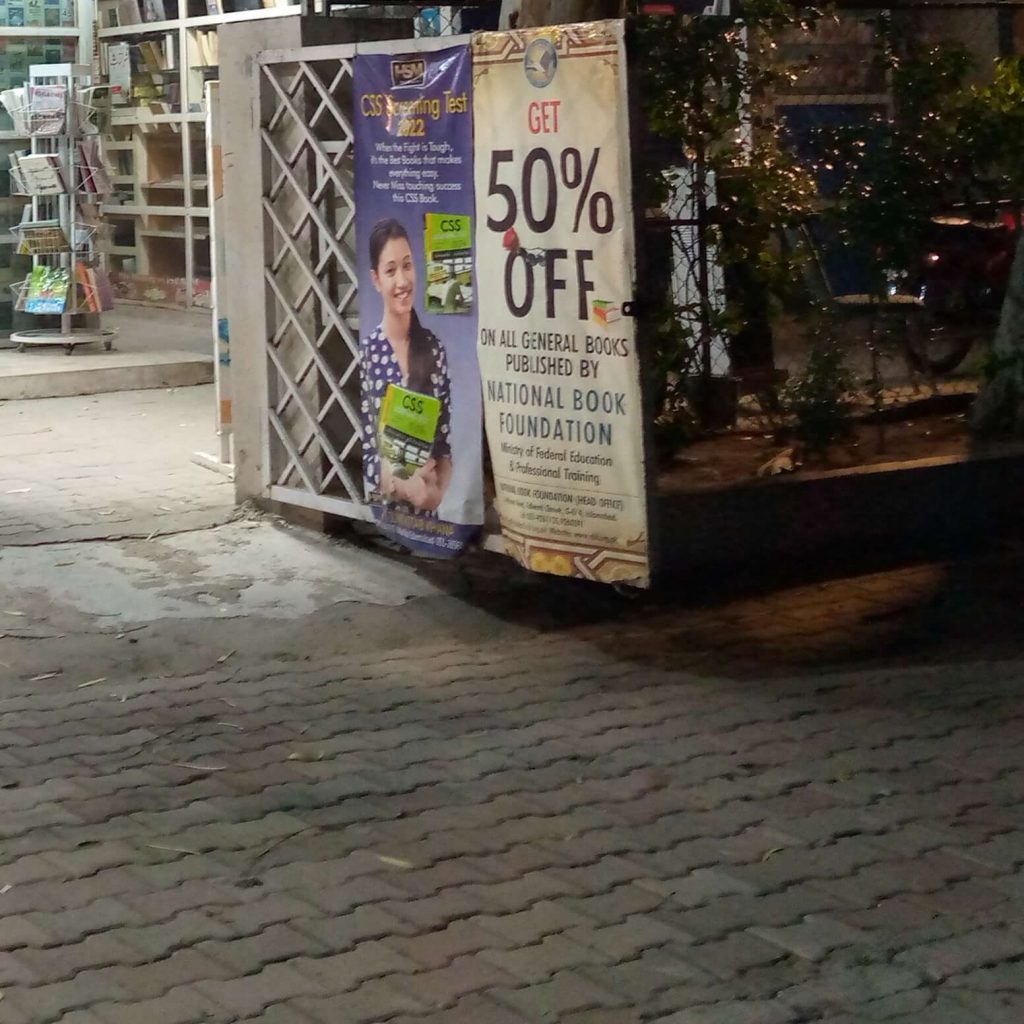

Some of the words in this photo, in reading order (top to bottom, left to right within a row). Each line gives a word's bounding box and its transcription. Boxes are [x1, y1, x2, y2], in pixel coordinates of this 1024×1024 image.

[361, 94, 382, 116] CSS
[443, 90, 468, 114] Test
[528, 100, 561, 134] GET
[486, 147, 615, 235] 50%
[440, 219, 462, 232] CSS
[503, 246, 597, 322] OFF
[480, 328, 496, 347] ON
[499, 330, 517, 349] ALL
[522, 331, 579, 354] GENERAL
[585, 335, 630, 358] BOOKS
[506, 353, 573, 377] PUBLISHED
[579, 359, 600, 379] BY
[402, 394, 424, 414] CSS
[487, 380, 565, 409] NATIONAL
[573, 389, 626, 416] BOOK
[499, 412, 612, 446] FOUNDATION
[535, 446, 567, 462] Federal
[569, 450, 613, 467] Education
[563, 467, 601, 486] Training
